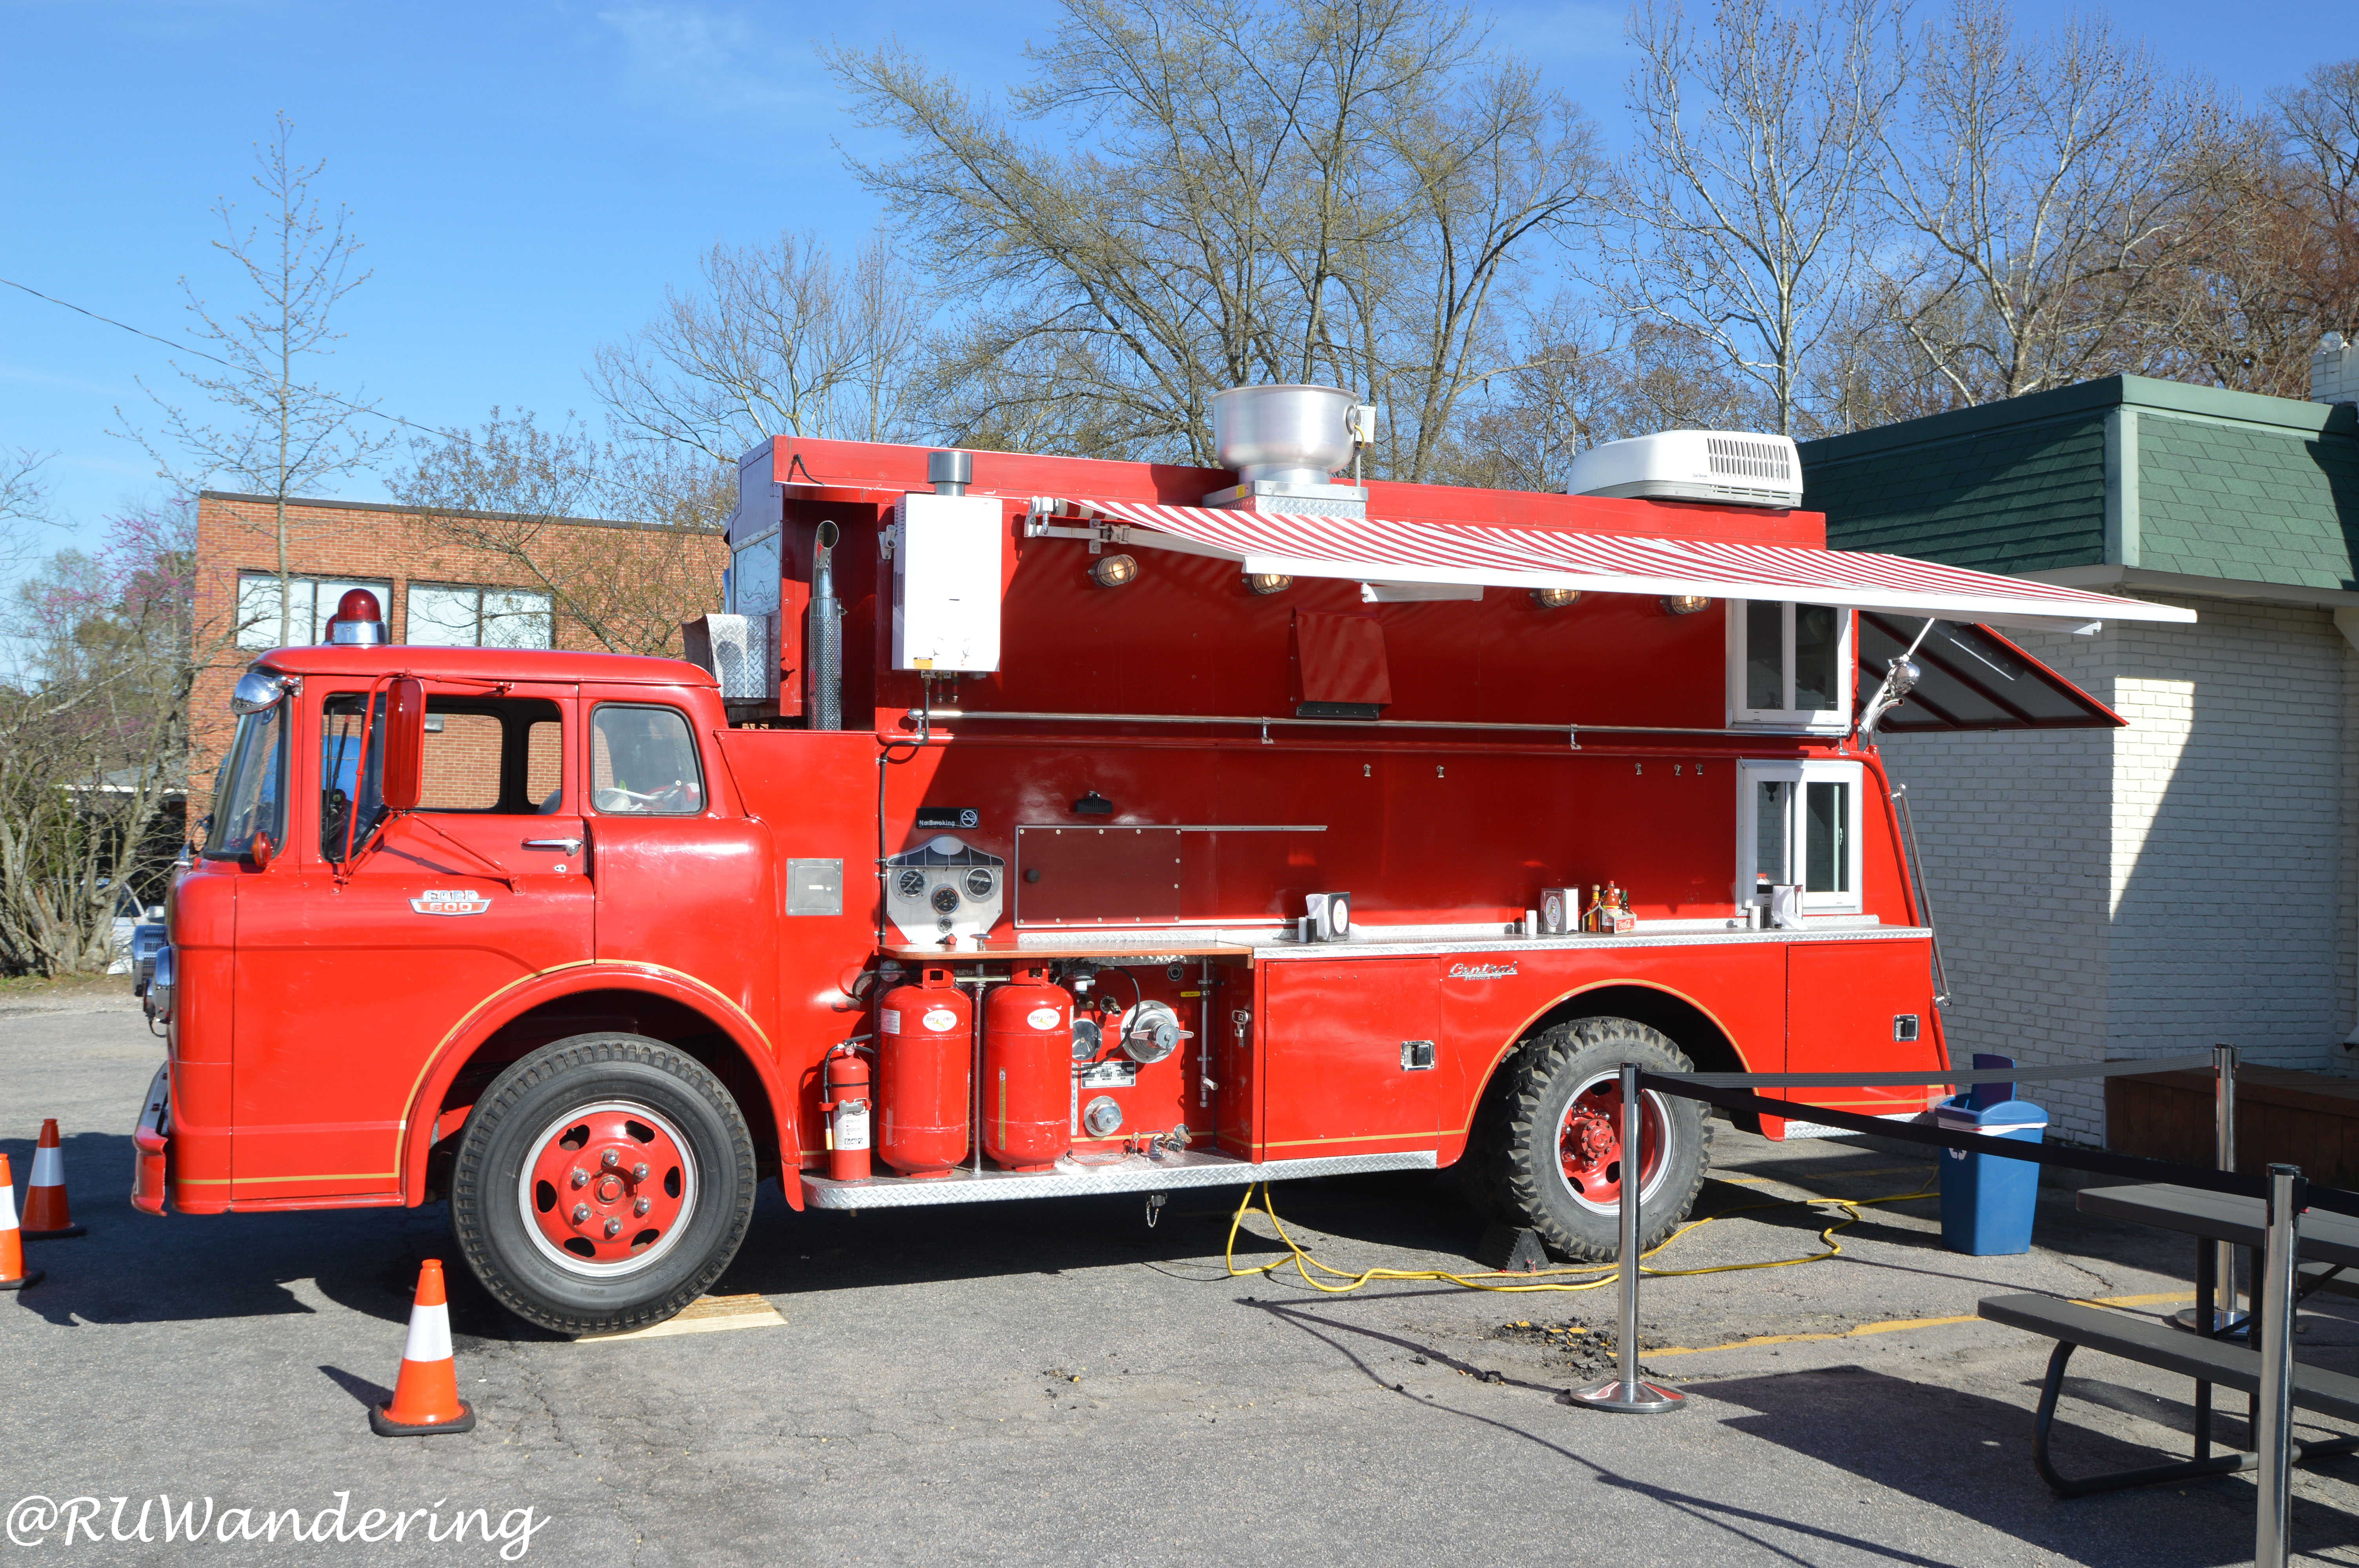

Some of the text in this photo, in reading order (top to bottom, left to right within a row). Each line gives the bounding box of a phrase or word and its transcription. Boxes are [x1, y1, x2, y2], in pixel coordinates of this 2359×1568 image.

[423, 890, 479, 901] FORD
[430, 902, 472, 911] 600
[1449, 960, 1518, 976] Central
